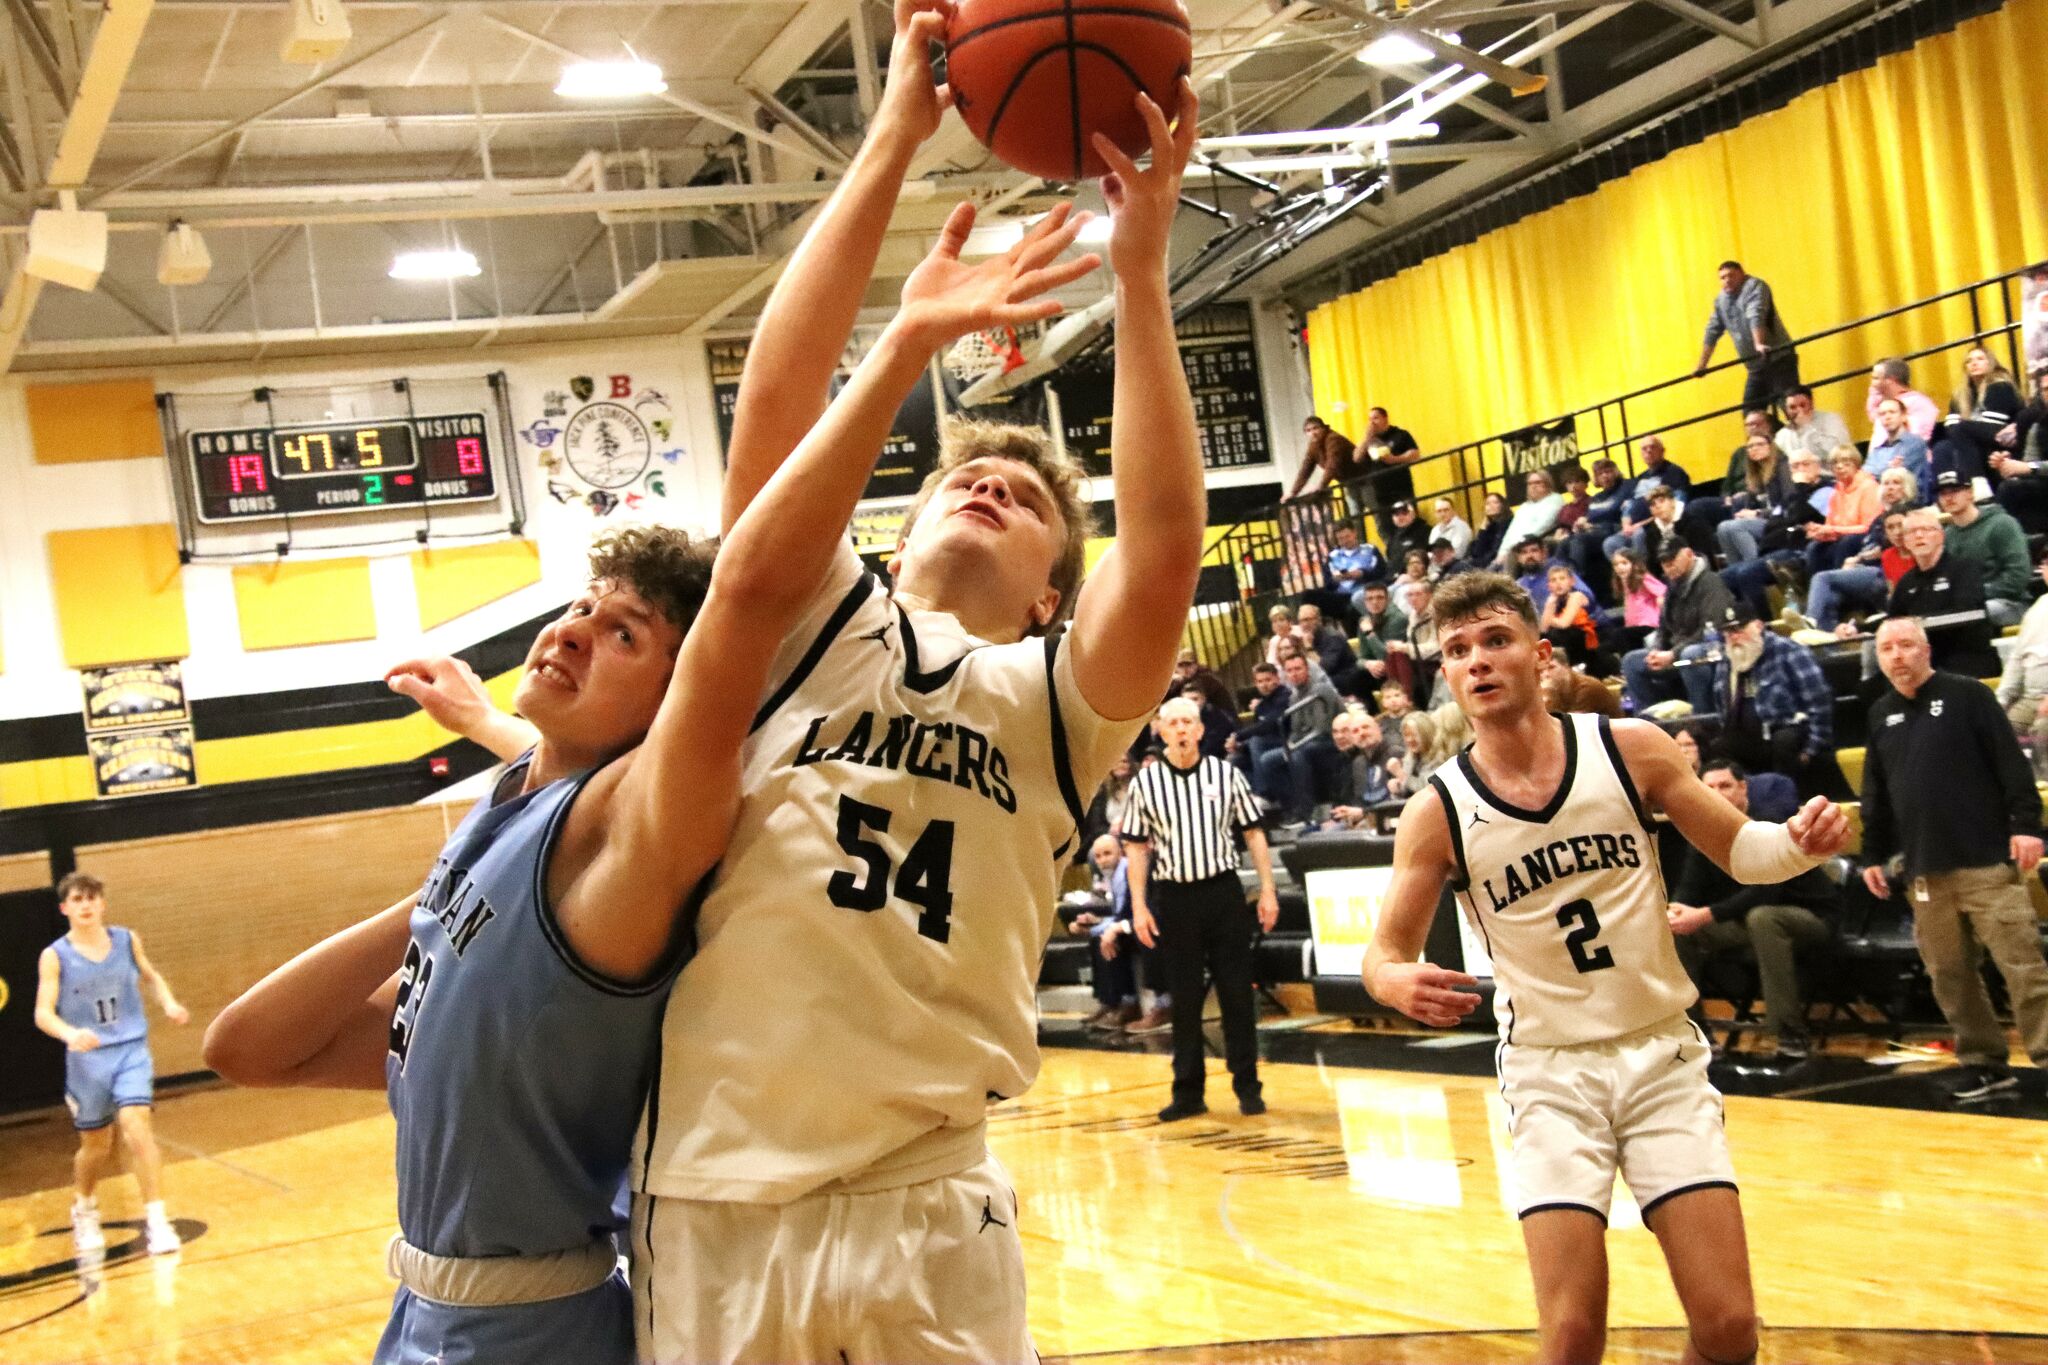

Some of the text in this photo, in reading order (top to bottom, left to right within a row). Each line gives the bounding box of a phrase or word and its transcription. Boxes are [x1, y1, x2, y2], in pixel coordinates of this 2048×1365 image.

[608, 374, 632, 399] B
[199, 432, 264, 453] HOME
[416, 417, 483, 439] VISITOR
[229, 438, 484, 493] 19 8
[284, 430, 382, 471] 47 5
[1503, 432, 1578, 475] Visitors
[229, 495, 276, 514] BONUS
[362, 474, 384, 504] 2
[424, 479, 468, 497] BONUS
[792, 711, 1017, 814] LANCERS
[826, 793, 955, 944] 54
[1483, 833, 1641, 913] LANCERS
[1555, 898, 1615, 973] 2
